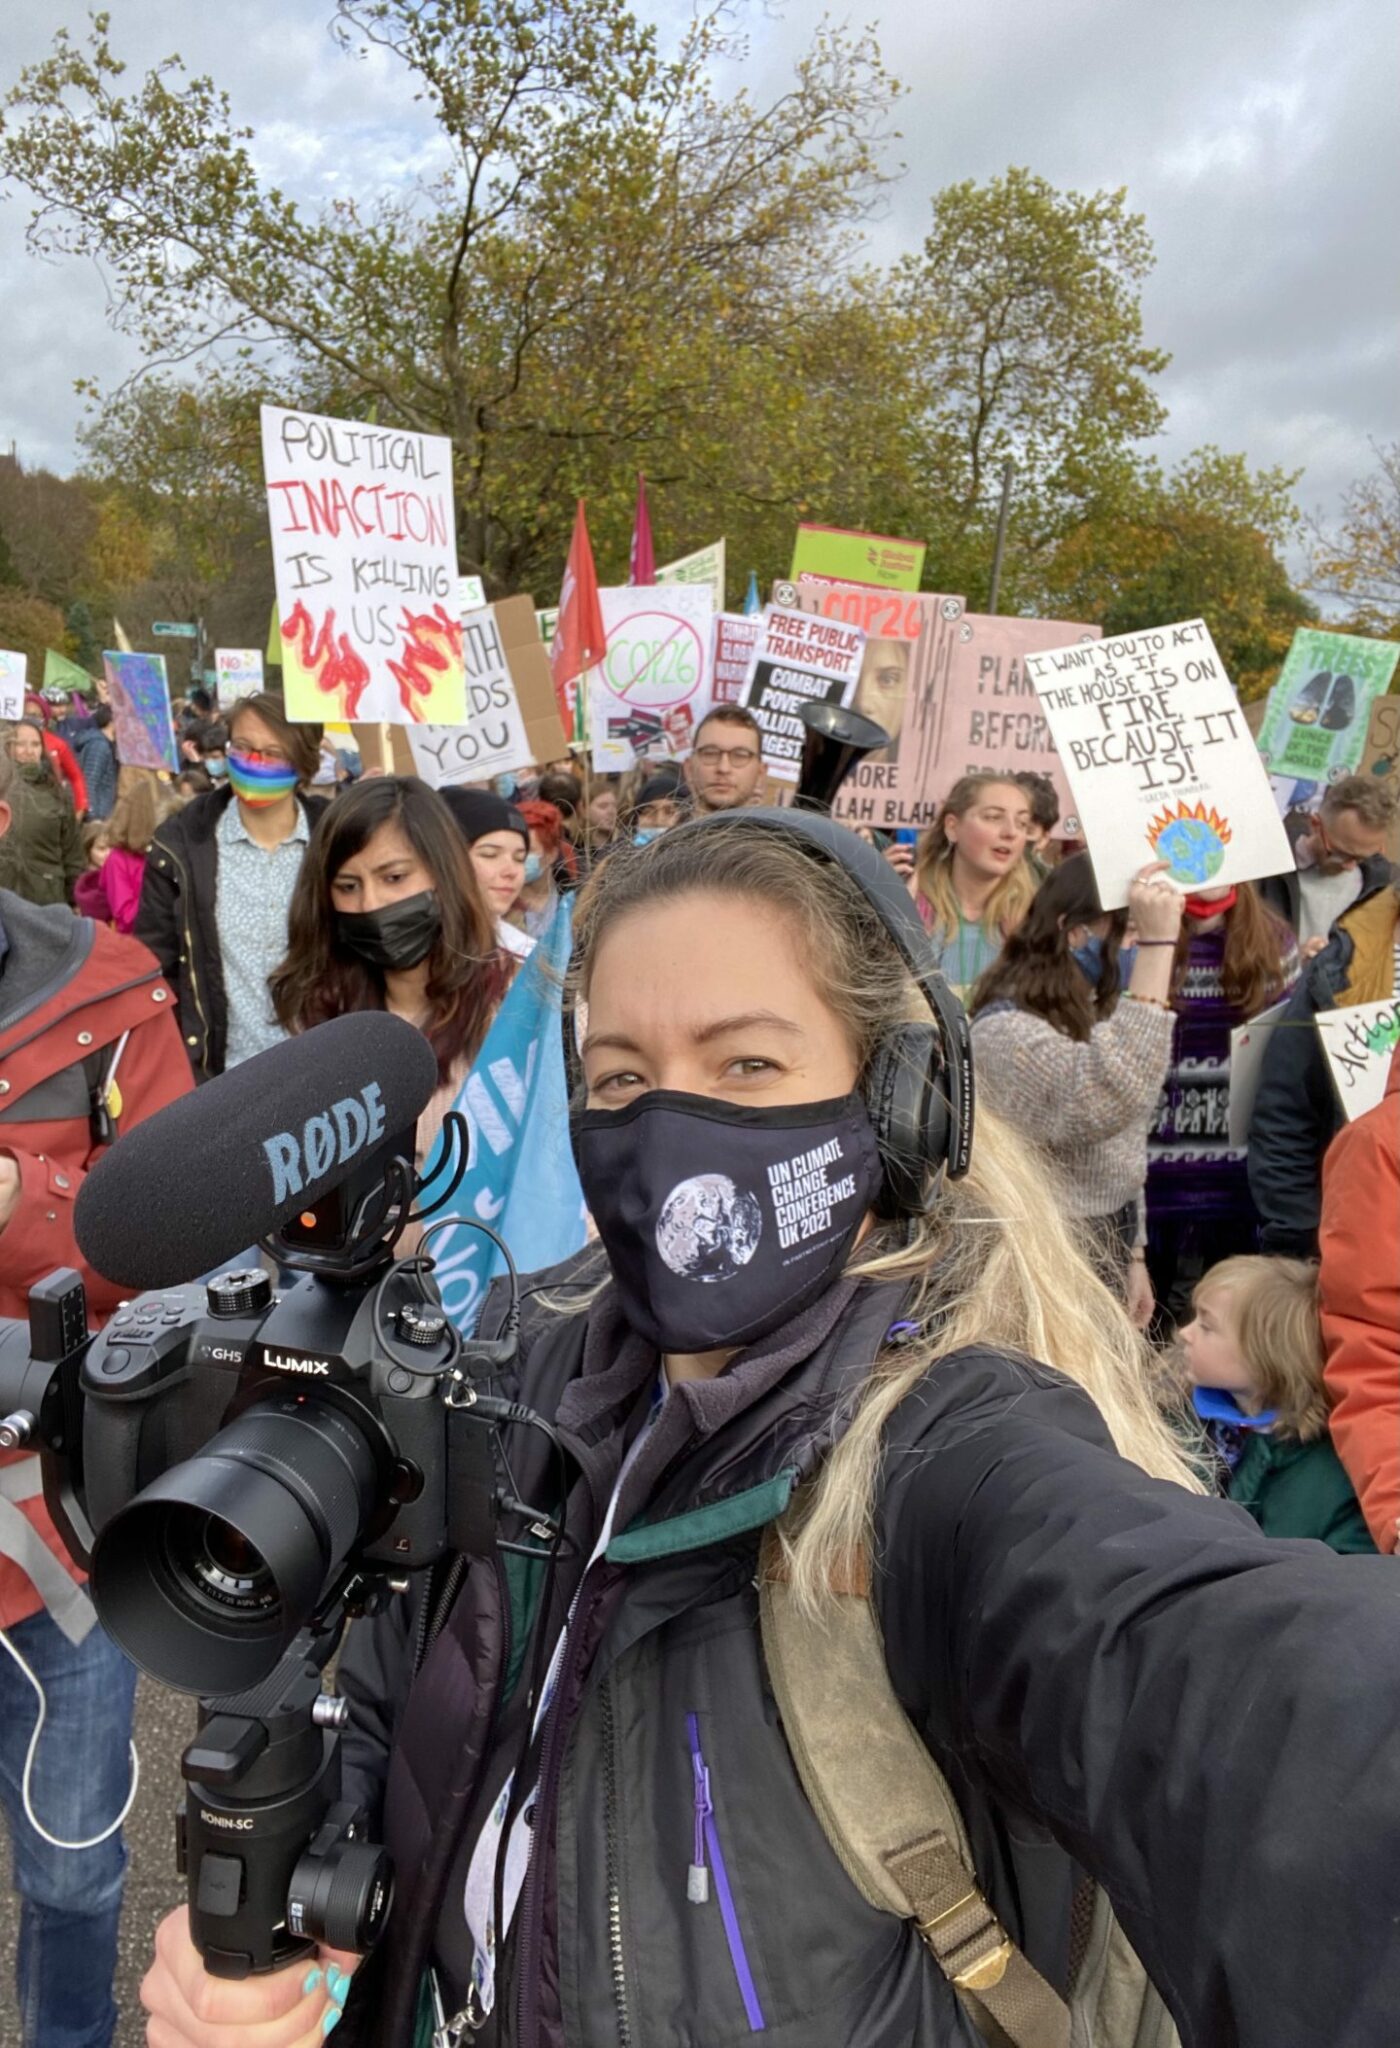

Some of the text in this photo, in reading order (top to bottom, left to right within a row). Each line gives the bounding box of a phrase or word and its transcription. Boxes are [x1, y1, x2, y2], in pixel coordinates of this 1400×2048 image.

[281, 416, 440, 480] POLITICAL
[268, 478, 447, 547] INACTION
[285, 552, 450, 597] IS KILLING
[352, 603, 396, 646] US
[767, 613, 860, 652] FREE PUBLIC
[608, 640, 696, 690] COP26
[766, 635, 853, 673] TRANSPORT
[1050, 648, 1095, 672] WANT
[1097, 639, 1136, 661] YOU
[1138, 634, 1165, 652] TO
[1172, 624, 1204, 647] ACT
[1094, 653, 1159, 682] AS IF
[759, 688, 806, 716] POVE
[769, 668, 833, 698] COMBAT
[1039, 658, 1218, 711] THE HOUSE IS ON
[750, 707, 805, 738] OLLUTI
[1069, 709, 1239, 771] BECAUSE IT
[420, 721, 510, 770] YOU
[835, 796, 936, 825] LAH BLAH
[262, 1081, 386, 1206] RØDE
[767, 1136, 844, 1187] UN CLIMATE
[771, 1167, 829, 1207] CHANGE
[775, 1173, 857, 1228] CONFERENCE
[778, 1225, 801, 1249] UK
[800, 1207, 832, 1240] 2021
[211, 1347, 243, 1363] GH5
[263, 1349, 330, 1376] LUMIX
[200, 1809, 255, 1831] RONIN-SC
